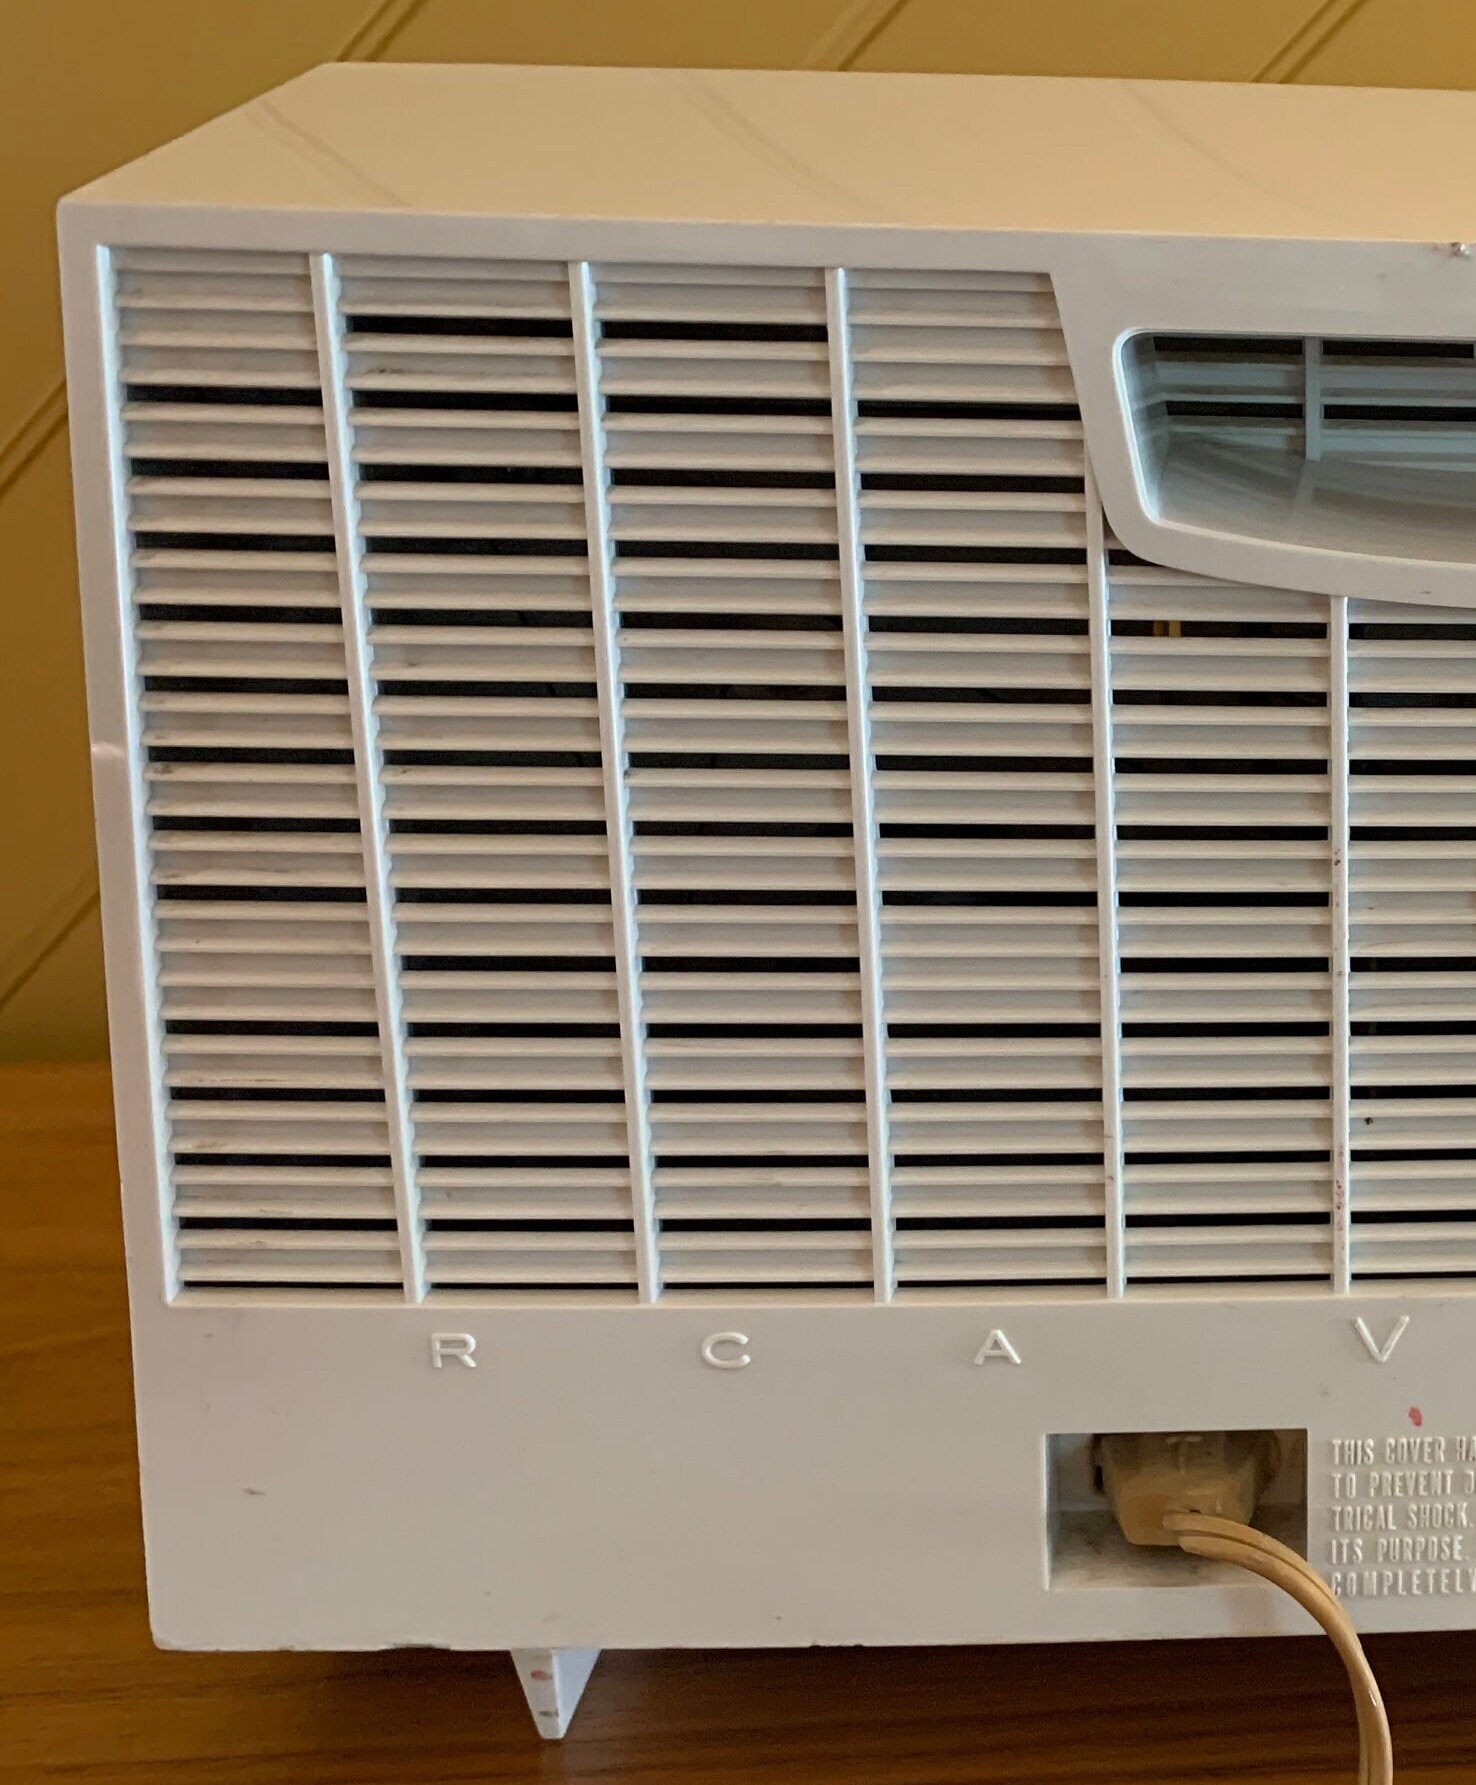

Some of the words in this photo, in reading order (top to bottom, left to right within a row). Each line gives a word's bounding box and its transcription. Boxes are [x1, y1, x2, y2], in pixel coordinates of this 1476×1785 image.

[1331, 1438, 1374, 1465] THIS
[1385, 1437, 1445, 1463] COVER
[1331, 1471, 1356, 1499] TO
[1369, 1470, 1454, 1497] PREVENT
[1331, 1505, 1397, 1531] TRICAL
[1407, 1502, 1475, 1529] SHOCK.
[1331, 1538, 1363, 1564] ITS
